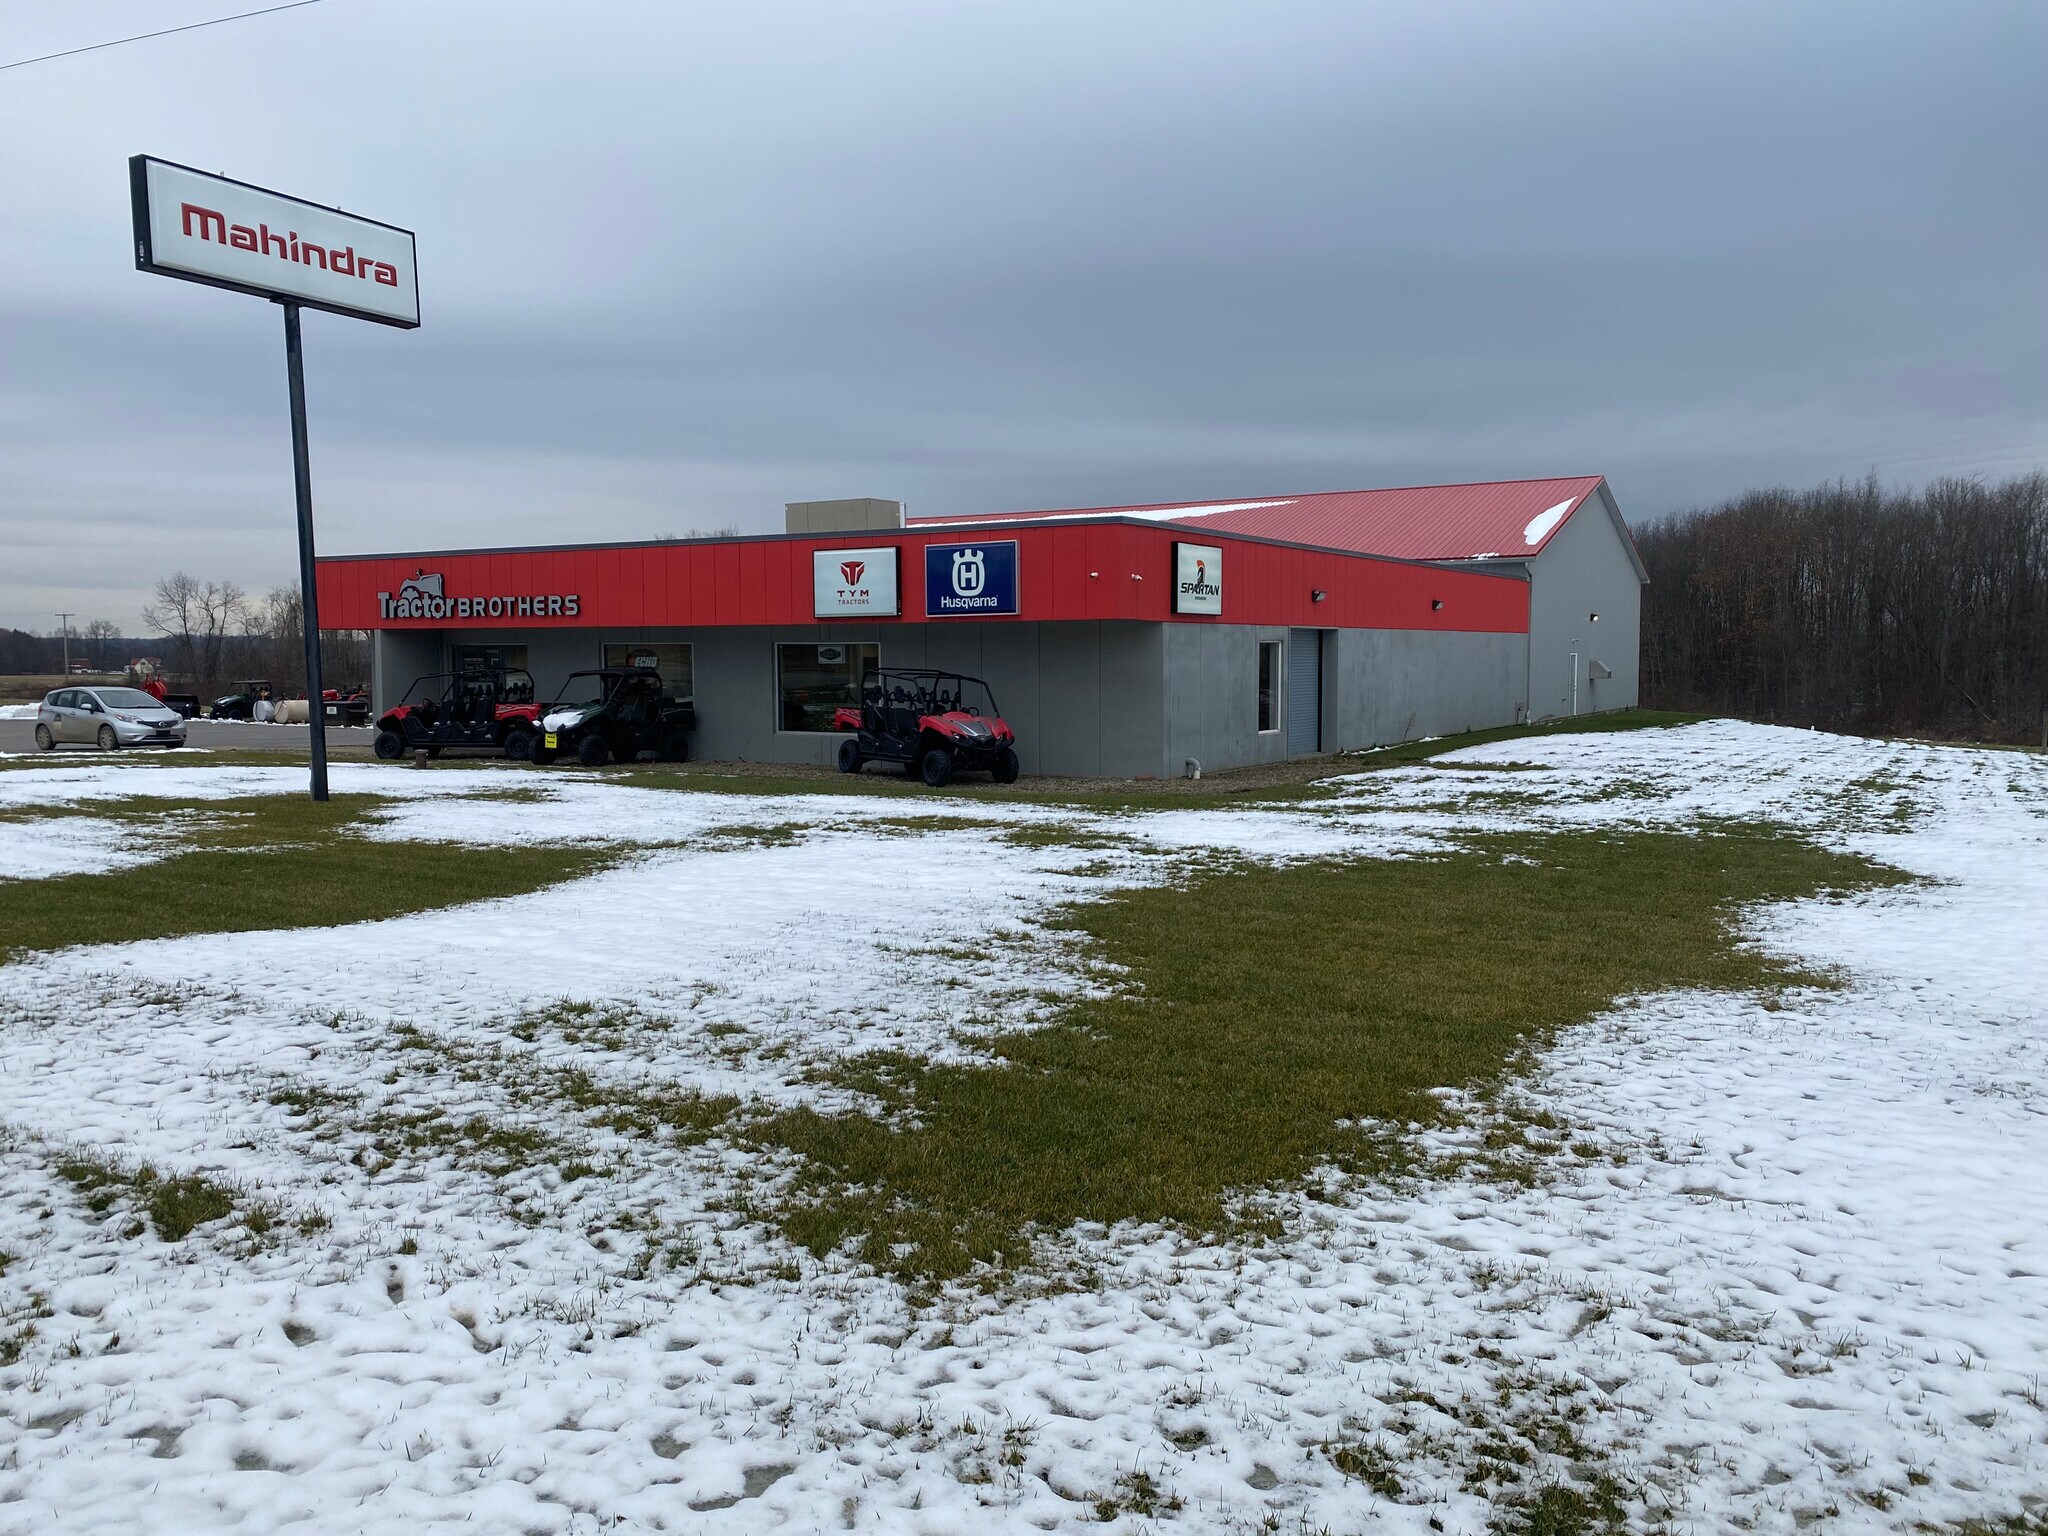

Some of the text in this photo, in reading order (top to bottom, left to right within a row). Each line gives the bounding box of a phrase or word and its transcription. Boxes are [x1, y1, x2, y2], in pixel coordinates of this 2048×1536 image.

[181, 202, 397, 287] Mahindra
[837, 589, 869, 598] TYM
[1180, 582, 1219, 596] SPARTAN
[940, 595, 998, 609] Husqvarna
[634, 656, 657, 668] ECHO
